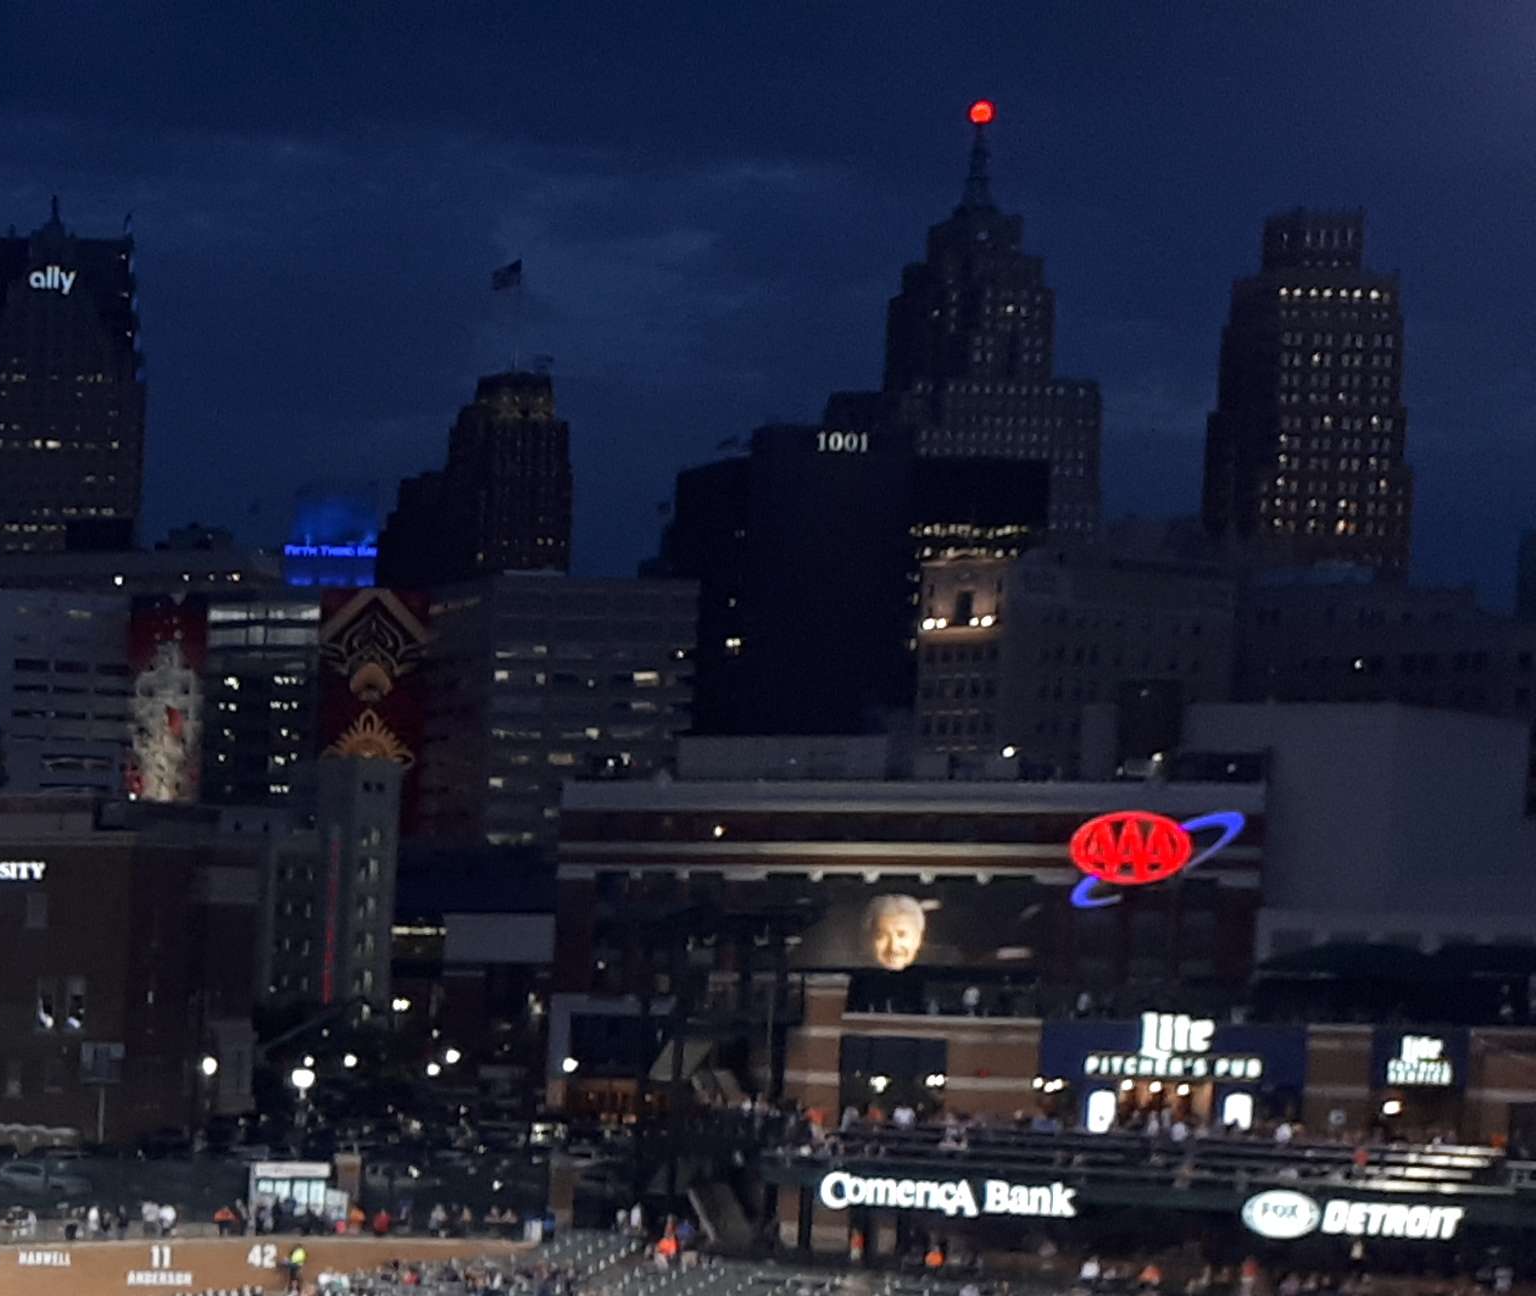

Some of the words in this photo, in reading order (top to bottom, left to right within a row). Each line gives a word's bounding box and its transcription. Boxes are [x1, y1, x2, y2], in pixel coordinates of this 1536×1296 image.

[29, 265, 77, 295] ally
[816, 430, 868, 453] 1001
[1140, 1012, 1215, 1060] Lite
[1084, 1054, 1208, 1077] PITCHER'S
[1214, 1058, 1263, 1079] PUB
[984, 1179, 1077, 1218] Bank
[1260, 1202, 1299, 1219] FOX
[1322, 1200, 1465, 1239] DETROIT
[151, 1244, 172, 1269] 11
[247, 1243, 277, 1269] 42
